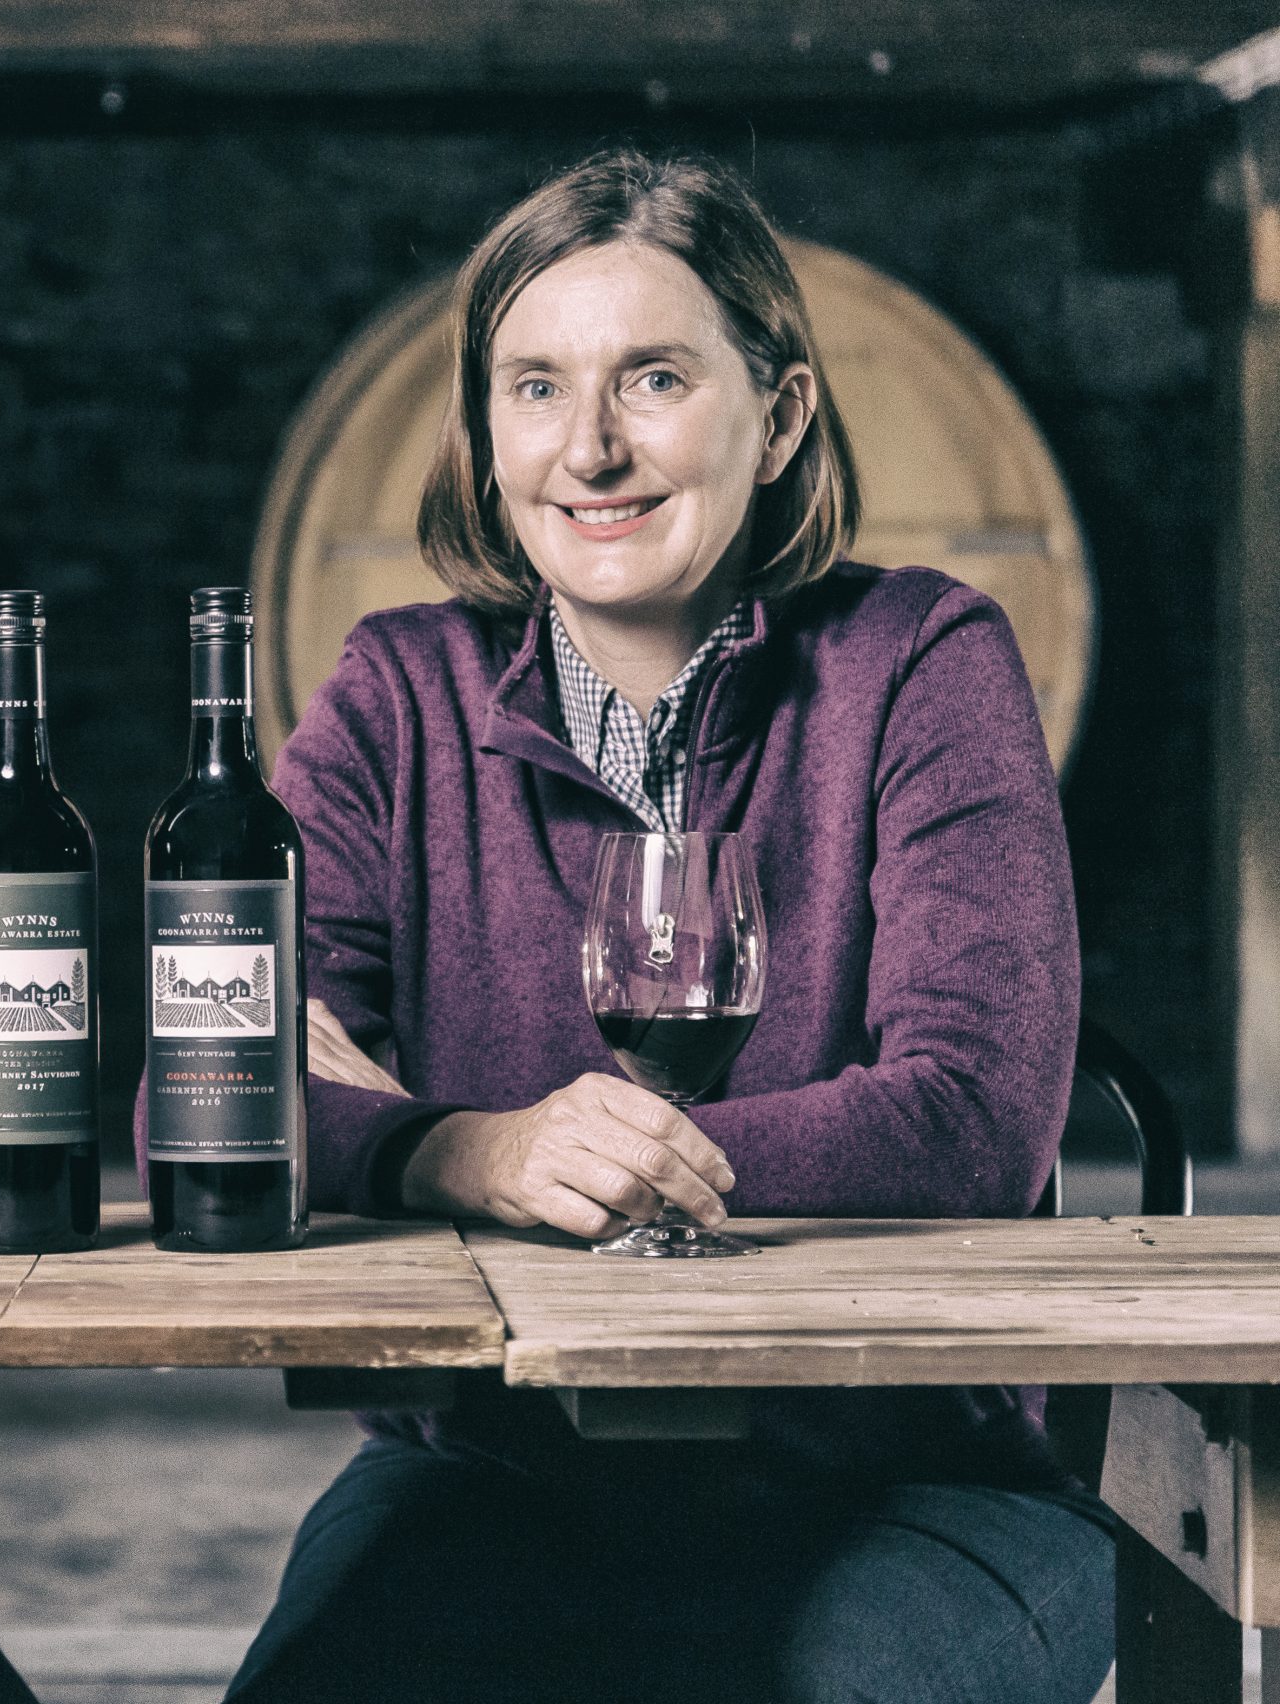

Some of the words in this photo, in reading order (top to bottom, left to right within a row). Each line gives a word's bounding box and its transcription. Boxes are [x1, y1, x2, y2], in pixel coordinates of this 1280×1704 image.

[1, 914, 58, 928] WYNNS
[180, 912, 235, 925] WYNNS
[47, 930, 81, 938] ESTATE
[158, 928, 219, 936] COONAWARRA
[223, 927, 264, 936] ESTATE
[177, 1050, 196, 1058] 61ST
[30, 1070, 81, 1080] SAUVIGNON
[166, 1072, 255, 1081] COONAWARRA
[17, 1083, 45, 1092] 2017
[157, 1087, 204, 1095] CABERNET
[209, 1086, 275, 1095] SAUVIGNON
[191, 1097, 221, 1106] 2016
